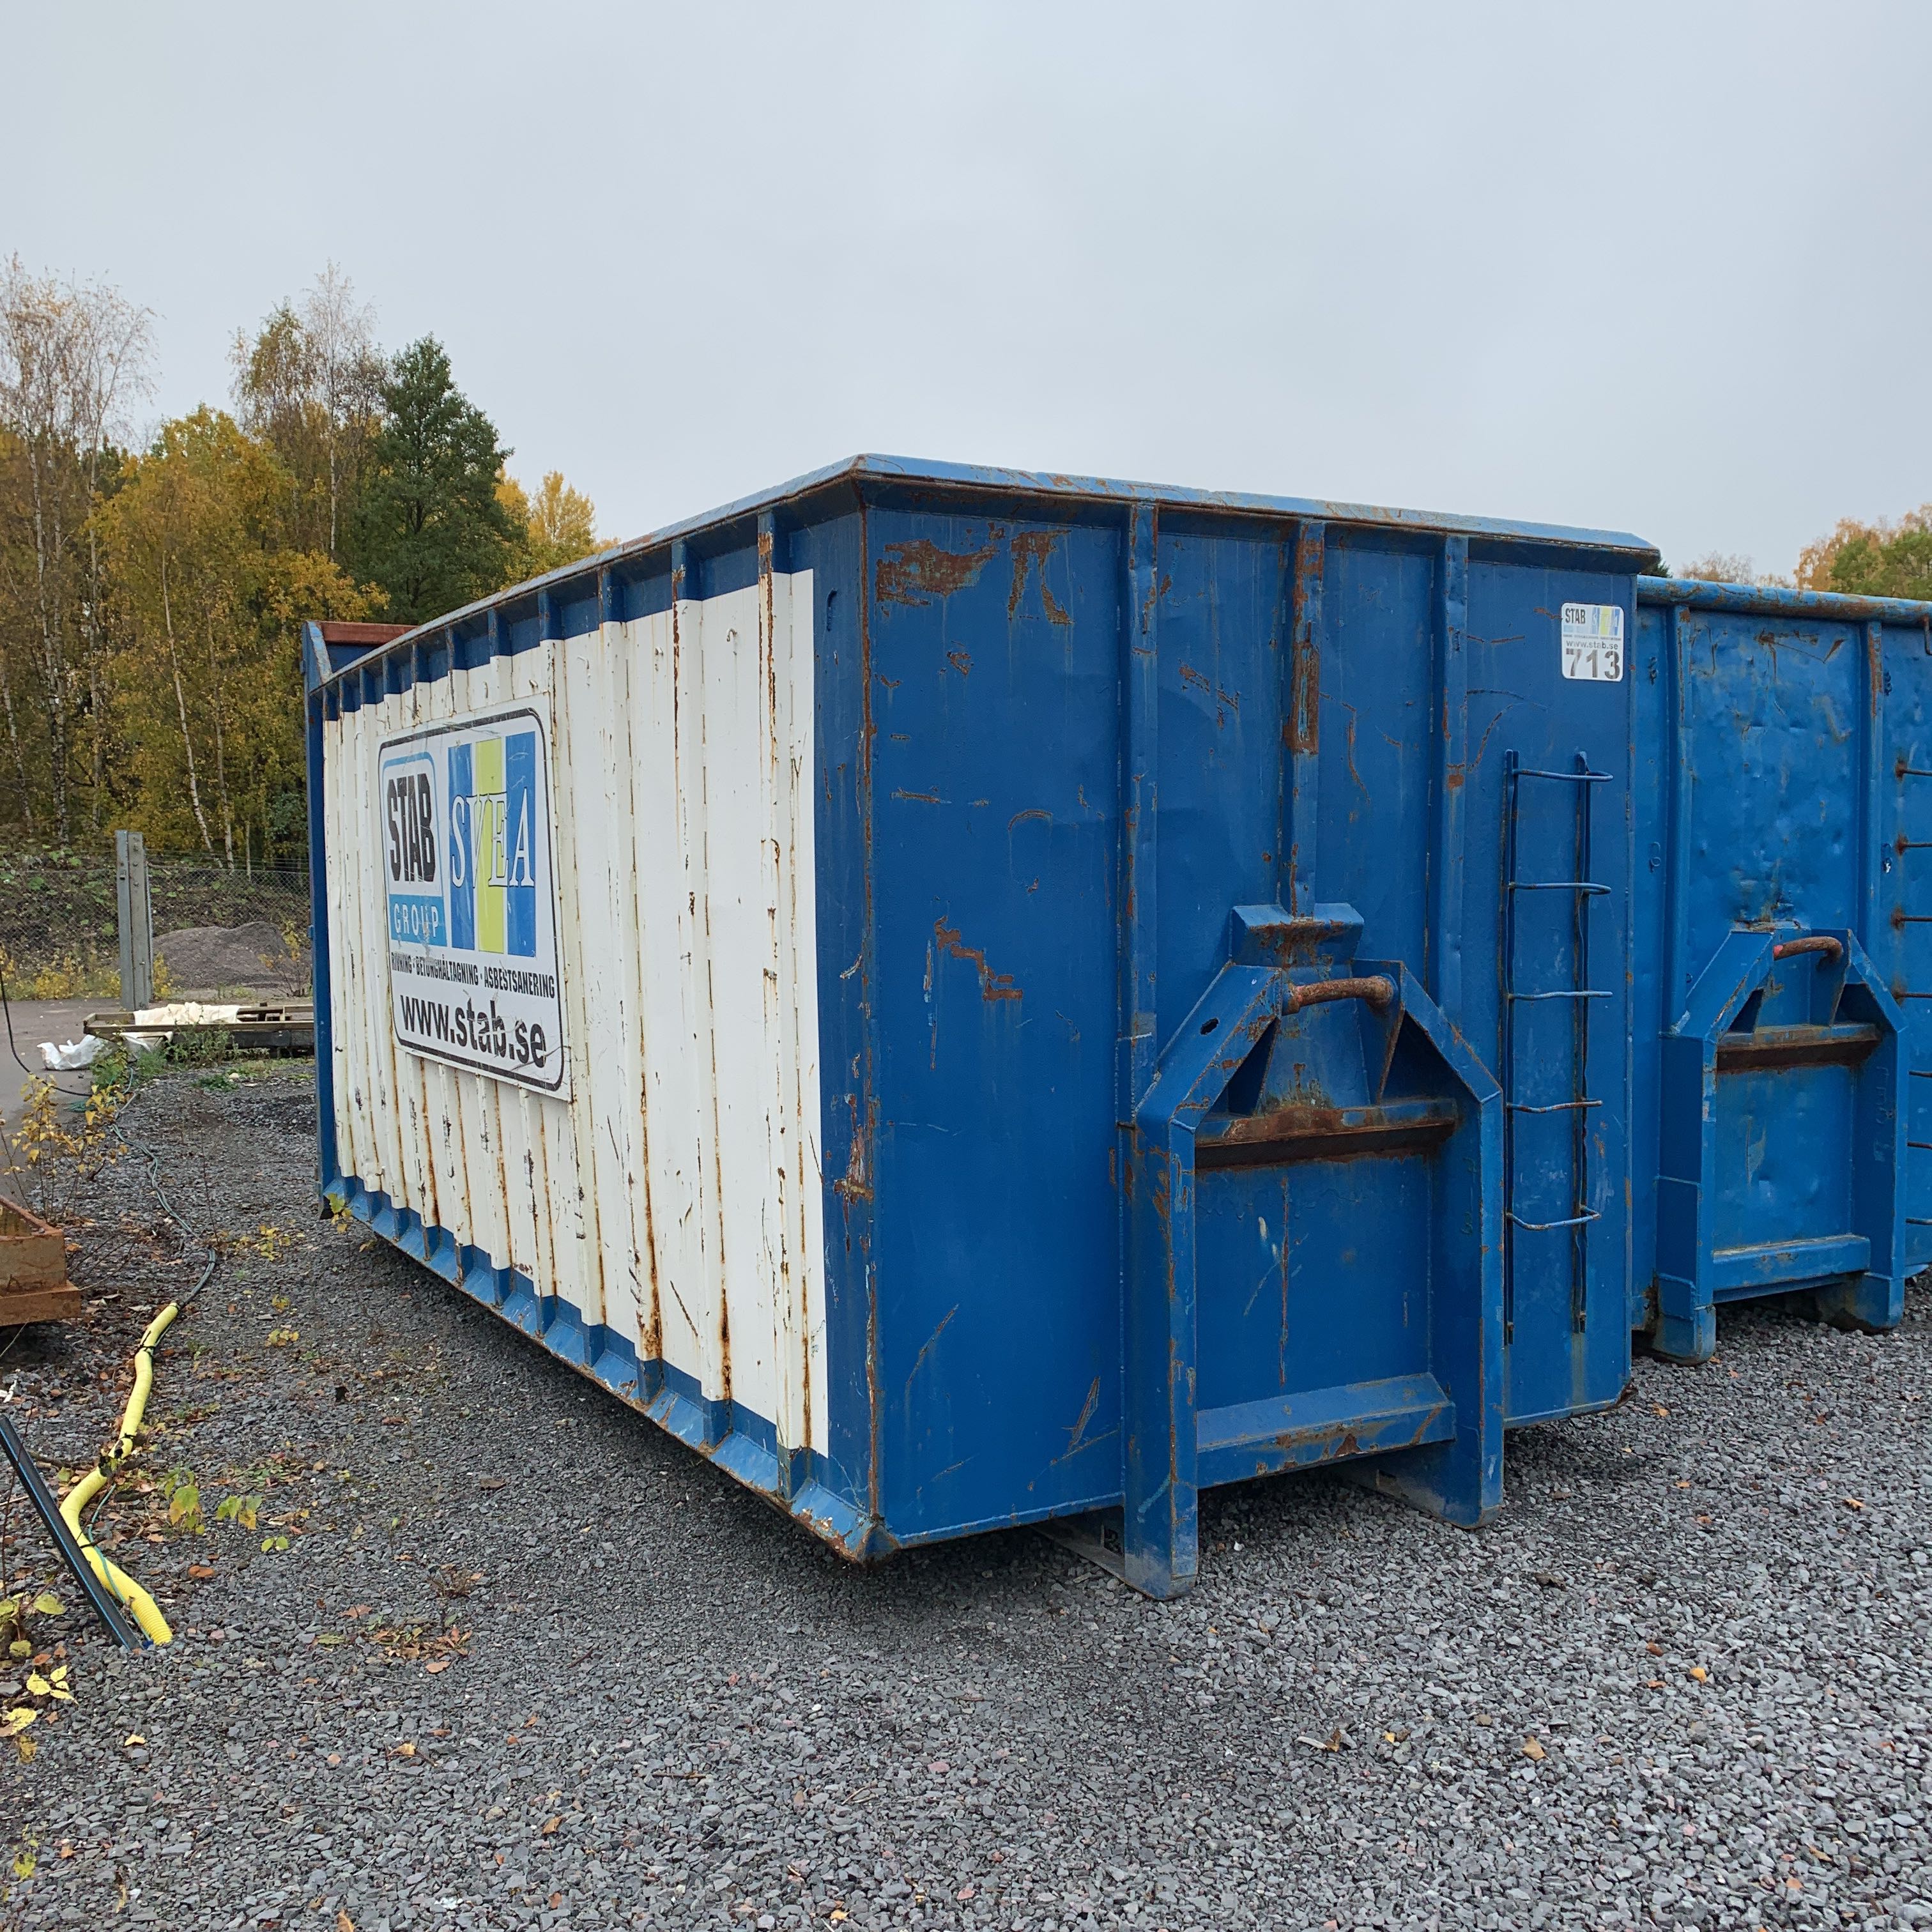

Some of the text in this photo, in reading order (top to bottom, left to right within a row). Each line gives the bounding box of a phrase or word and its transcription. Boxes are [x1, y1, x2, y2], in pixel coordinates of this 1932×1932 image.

[1565, 608, 1586, 624] STAB
[1566, 640, 1618, 650] www.stab.se
[1566, 648, 1620, 680] 713
[387, 773, 436, 882] STAB
[451, 786, 535, 889] SVEA
[394, 903, 438, 937] GROUP
[484, 966, 555, 999] ASBESTSANERING
[400, 995, 547, 1068] www.stab.se
